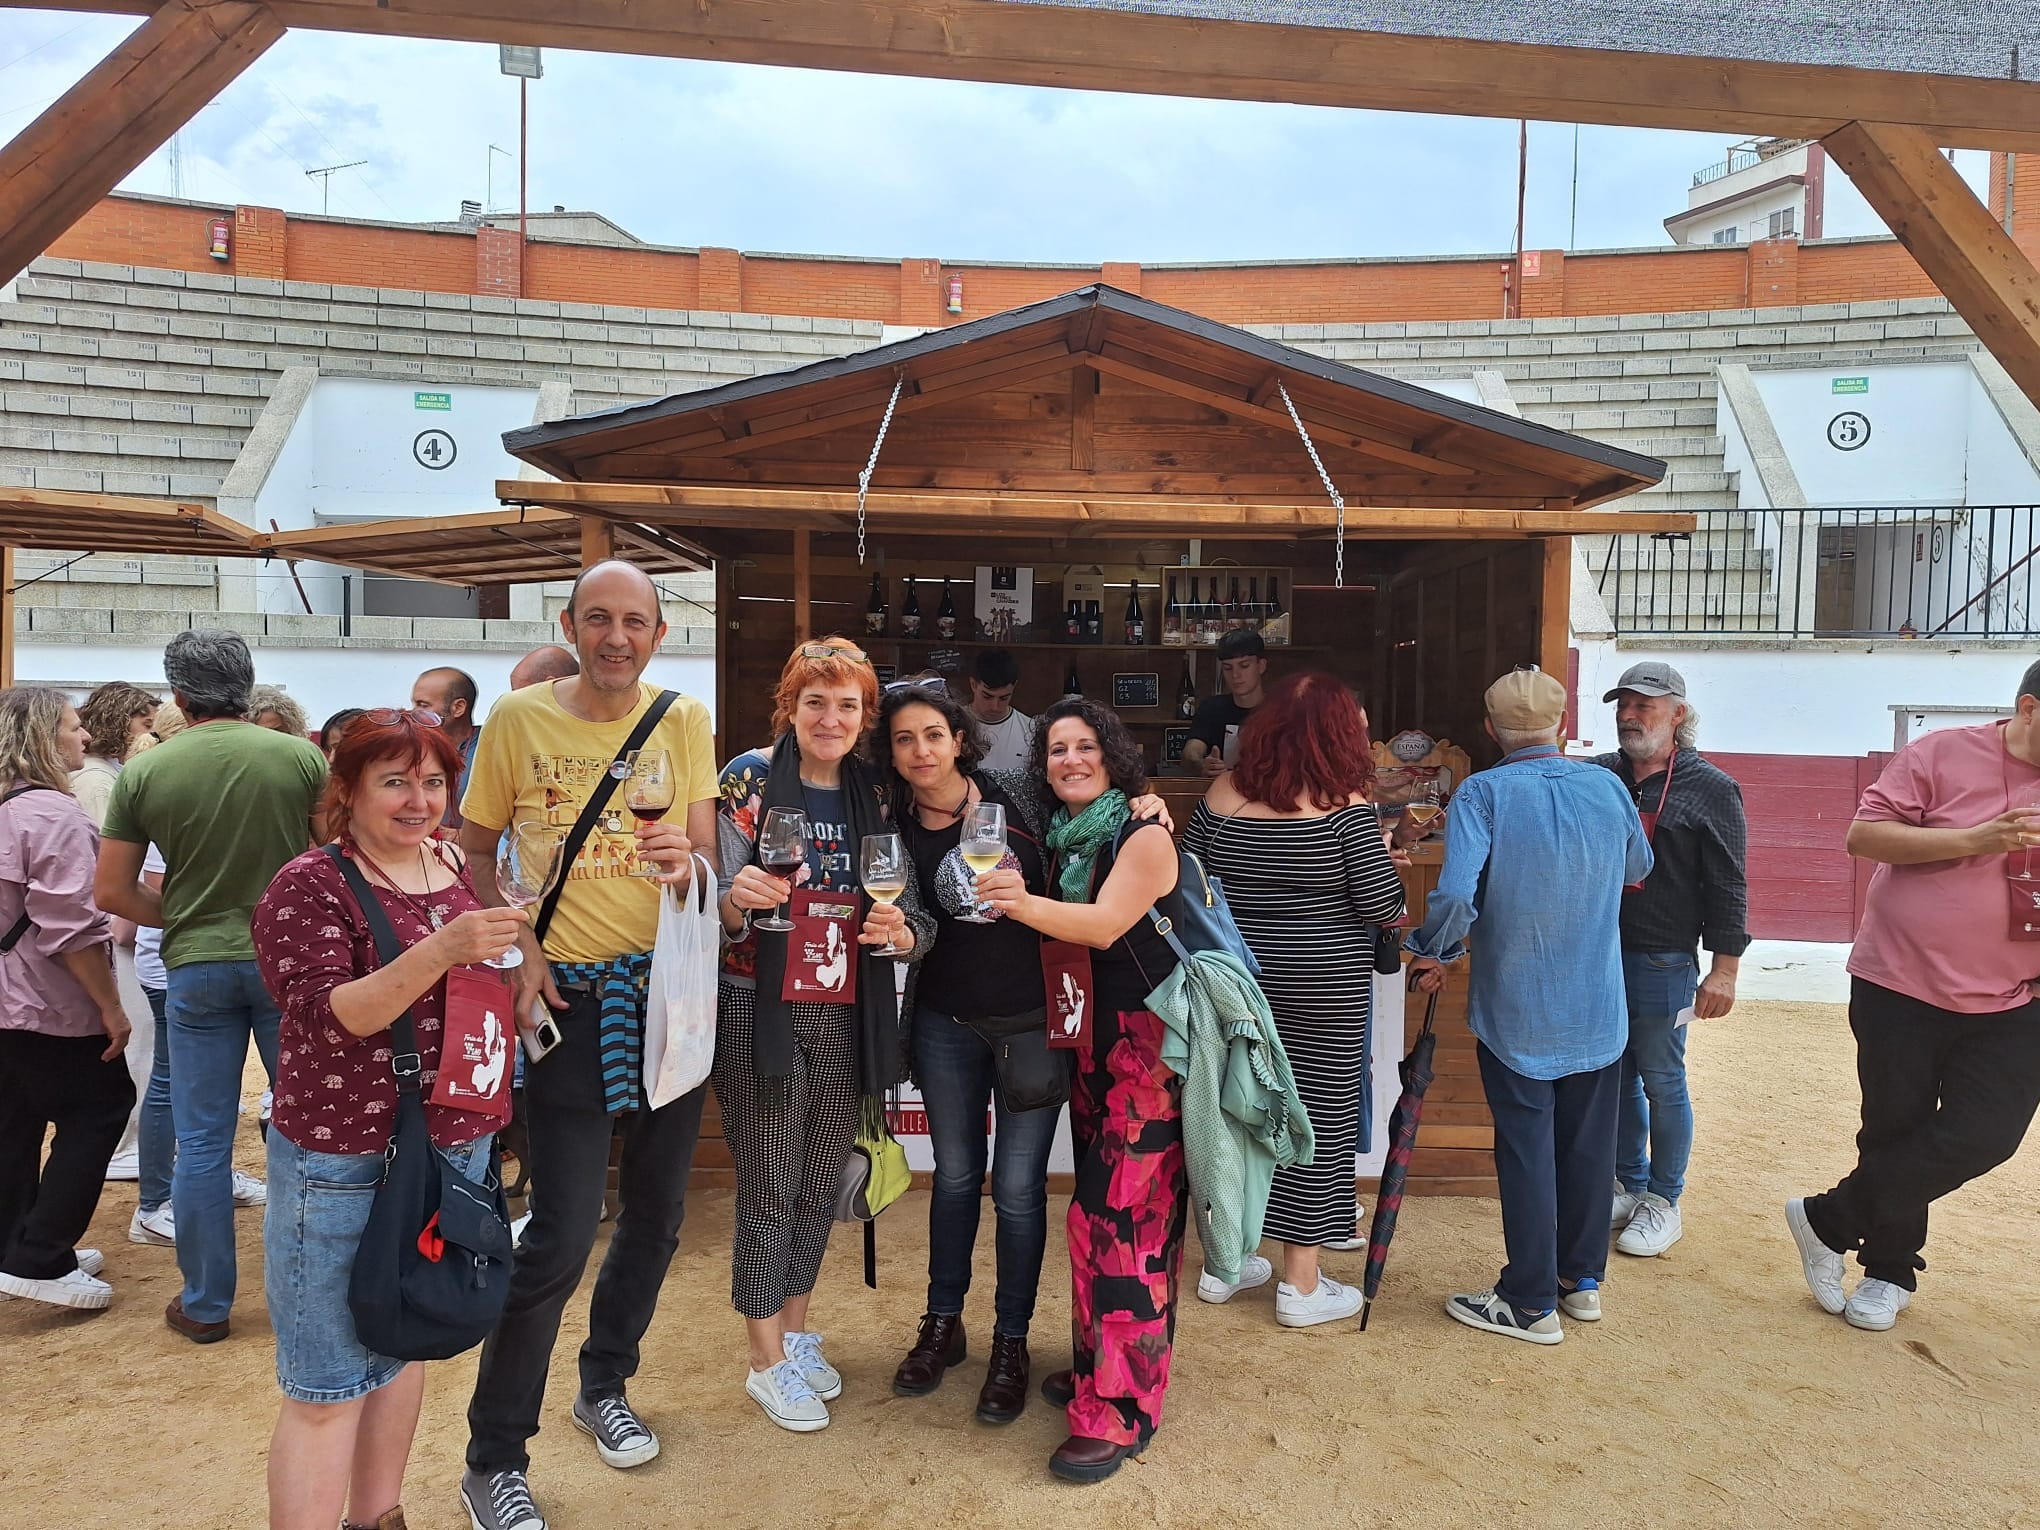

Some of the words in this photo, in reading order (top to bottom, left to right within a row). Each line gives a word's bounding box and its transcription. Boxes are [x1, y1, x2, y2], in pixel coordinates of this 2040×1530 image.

[1840, 420, 1858, 441] 5
[423, 438, 441, 461] 4
[1916, 715, 1925, 726] 7
